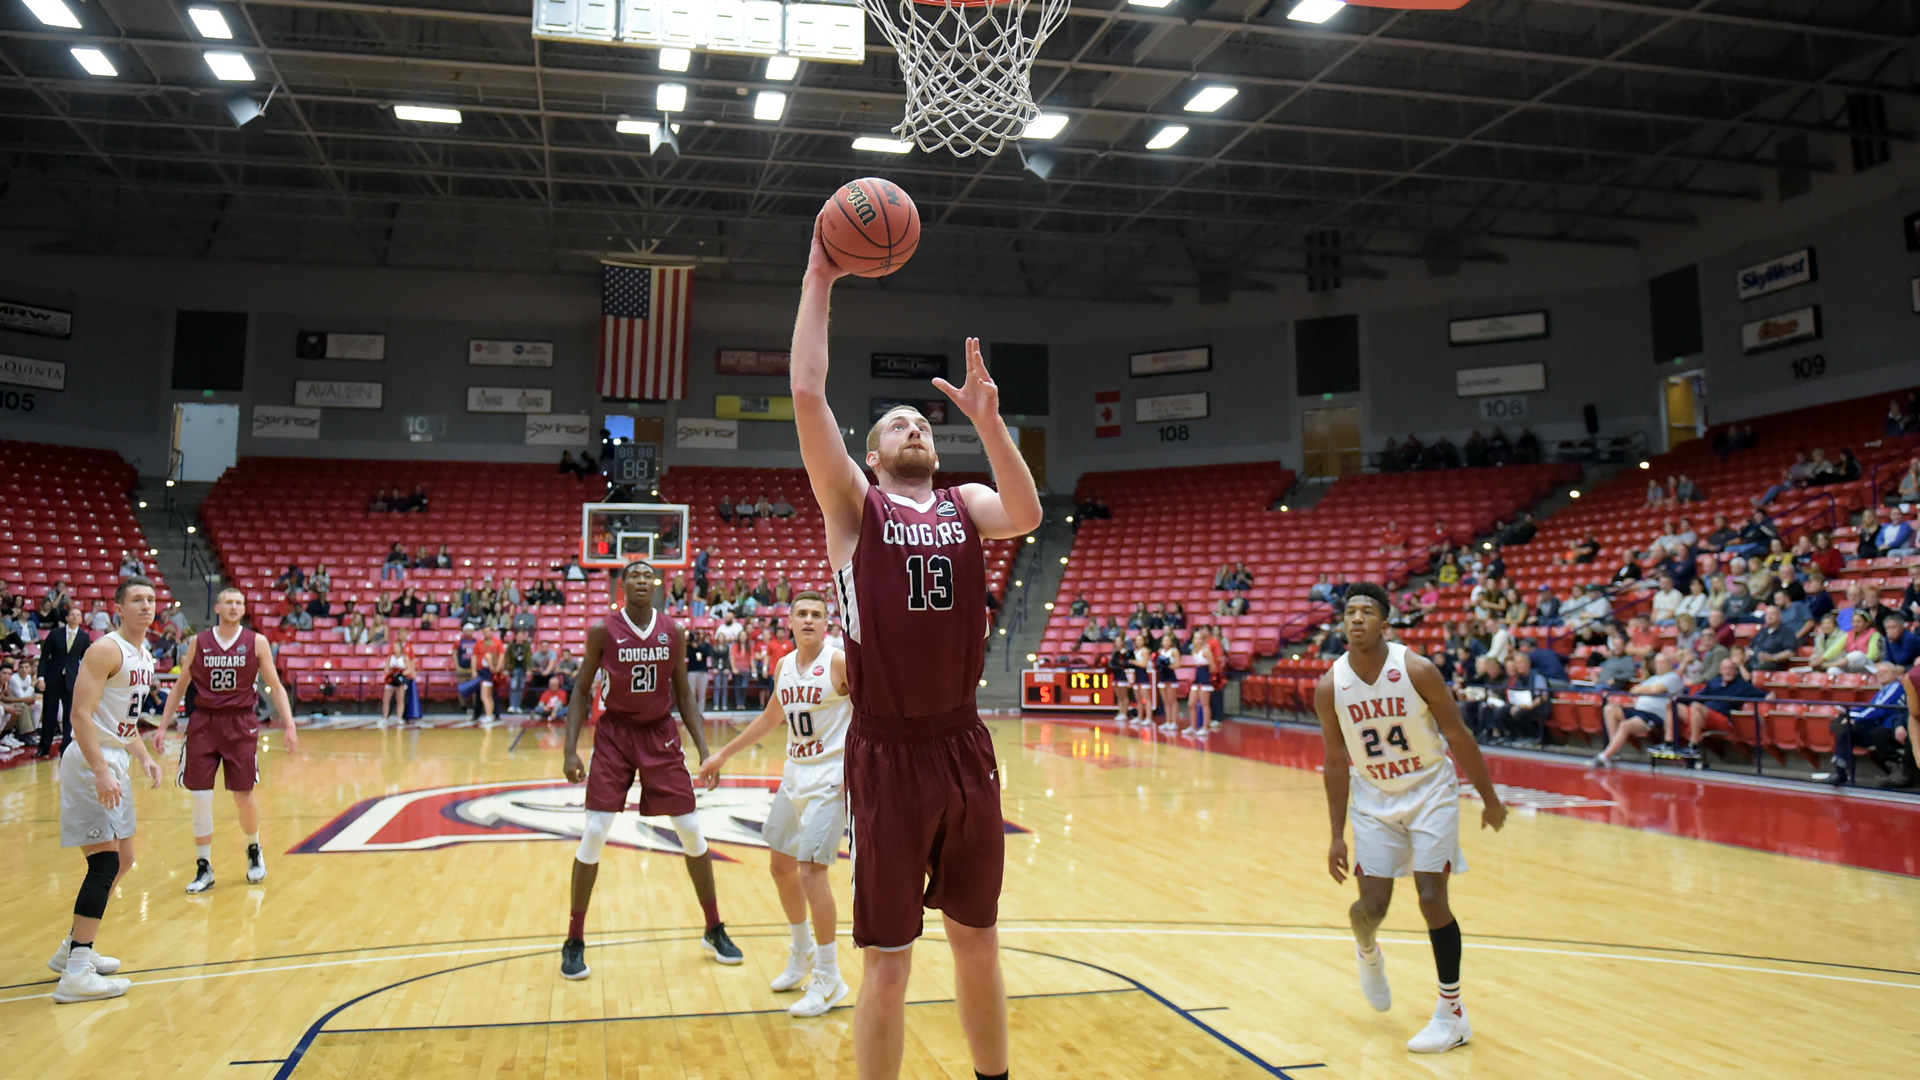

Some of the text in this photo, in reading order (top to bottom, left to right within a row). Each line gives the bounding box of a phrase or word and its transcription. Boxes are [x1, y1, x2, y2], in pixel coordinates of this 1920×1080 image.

[845, 181, 877, 227] Wilso
[1742, 258, 1804, 290] SkyWest
[1792, 354, 1826, 379] 109
[306, 383, 372, 399] AVALON
[1485, 399, 1524, 418] 108
[1158, 425, 1189, 442] 108
[906, 554, 954, 611] 13
[203, 655, 246, 667] COUGARS
[618, 646, 669, 662] COUGARS
[211, 668, 237, 691] 23
[631, 664, 657, 693] 21
[1034, 673, 1054, 682] DIXIE
[1071, 673, 1108, 689] 17:11
[780, 686, 822, 705] DIXIE
[1347, 697, 1407, 724] DIXIE
[788, 710, 815, 738] 10
[1360, 723, 1412, 759] 24
[1366, 756, 1423, 780] STATE
